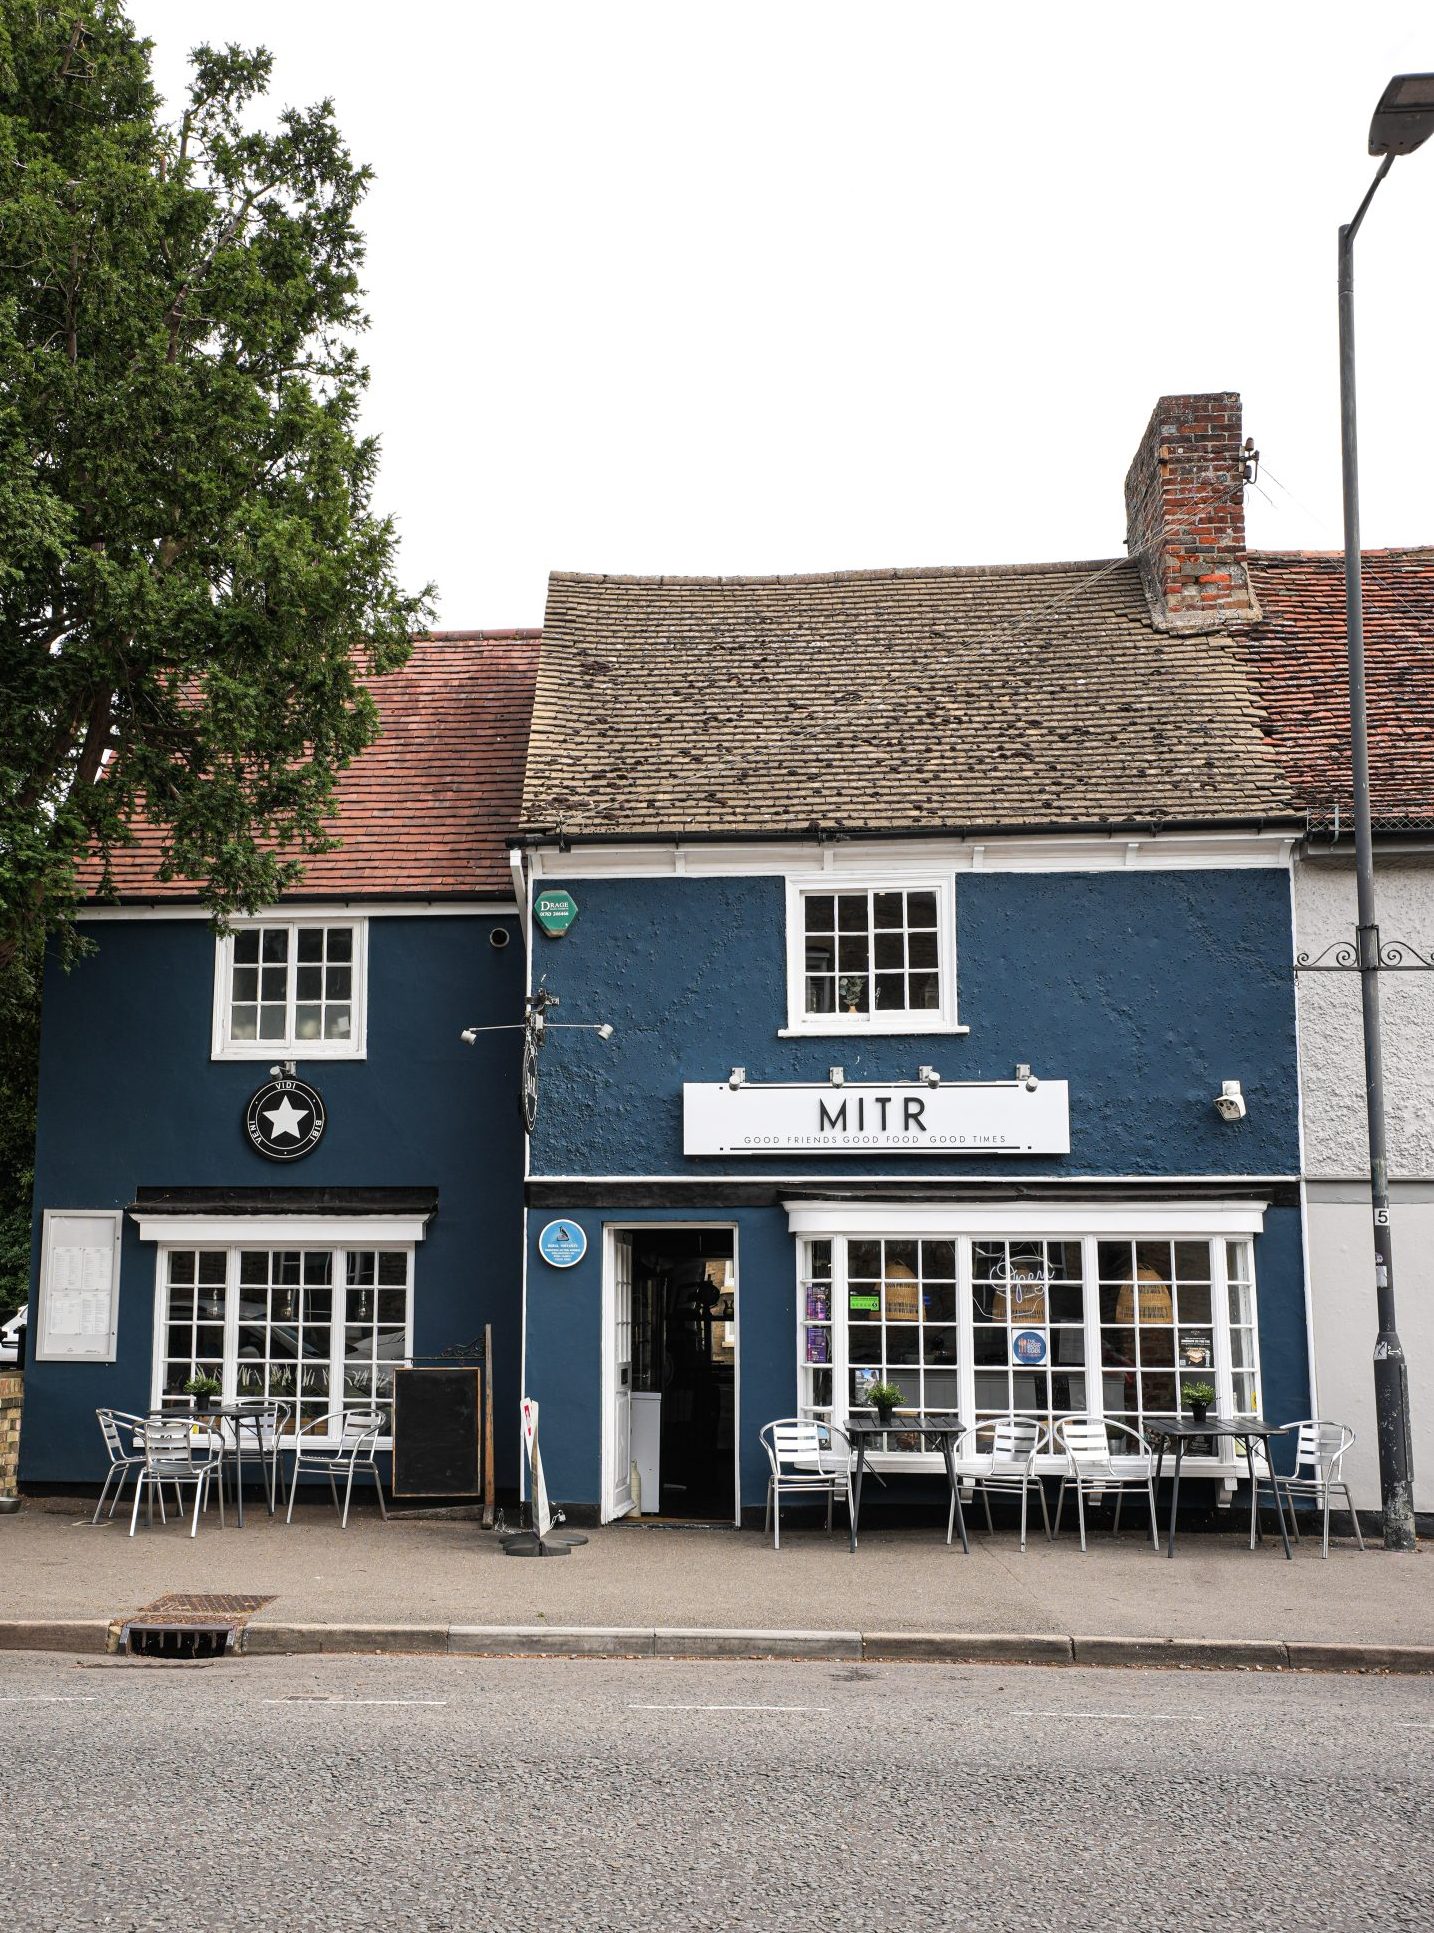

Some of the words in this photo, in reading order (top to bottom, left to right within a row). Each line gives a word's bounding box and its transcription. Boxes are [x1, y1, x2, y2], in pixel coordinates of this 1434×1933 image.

[541, 901, 569, 911] DRAGE
[275, 1082, 297, 1090] VIDI
[819, 1097, 928, 1132] MITR
[248, 1120, 262, 1144] VENI
[311, 1119, 323, 1141] BIBI
[744, 1135, 781, 1145] GOOD
[787, 1135, 838, 1145] FRIENDS
[842, 1135, 879, 1145] GOOD
[886, 1135, 919, 1145] FOOD
[929, 1135, 966, 1145] GOOD
[973, 1135, 1006, 1145] TIMES
[1377, 1210, 1389, 1224] 5
